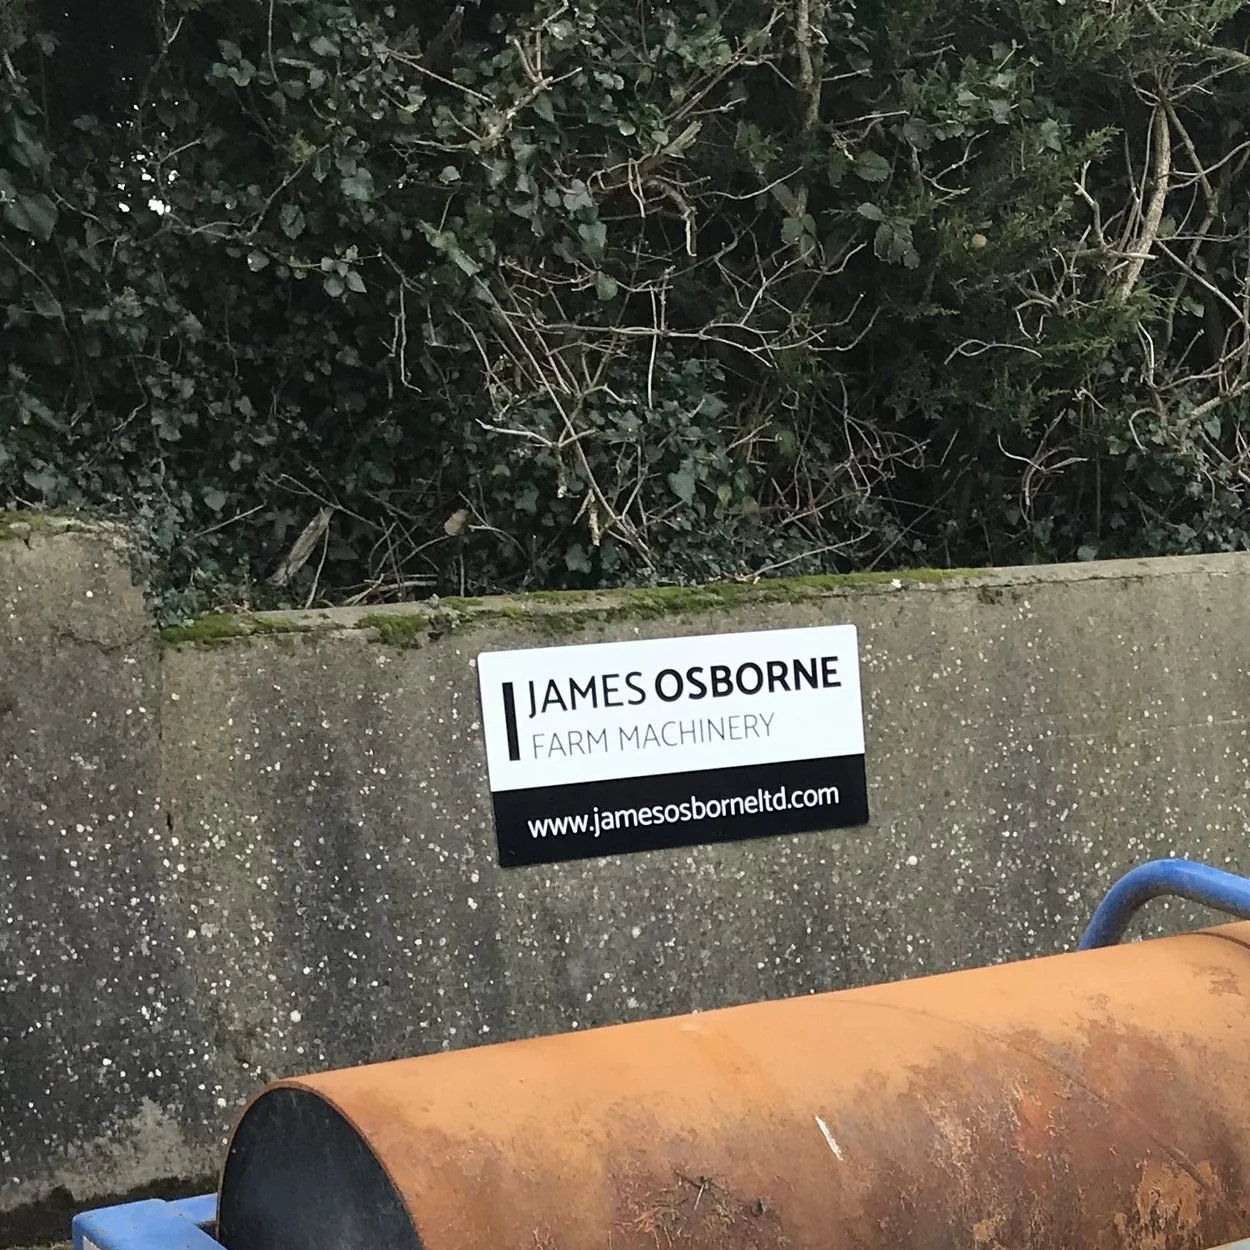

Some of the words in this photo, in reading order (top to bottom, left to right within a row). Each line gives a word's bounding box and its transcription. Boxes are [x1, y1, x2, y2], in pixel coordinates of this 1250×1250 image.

[529, 671, 646, 719] JAMES
[654, 656, 842, 702] OSBORNE
[532, 728, 608, 760] FARM
[620, 712, 775, 751] MACHINERY
[527, 786, 840, 838] www.jamesosborneltd.com
